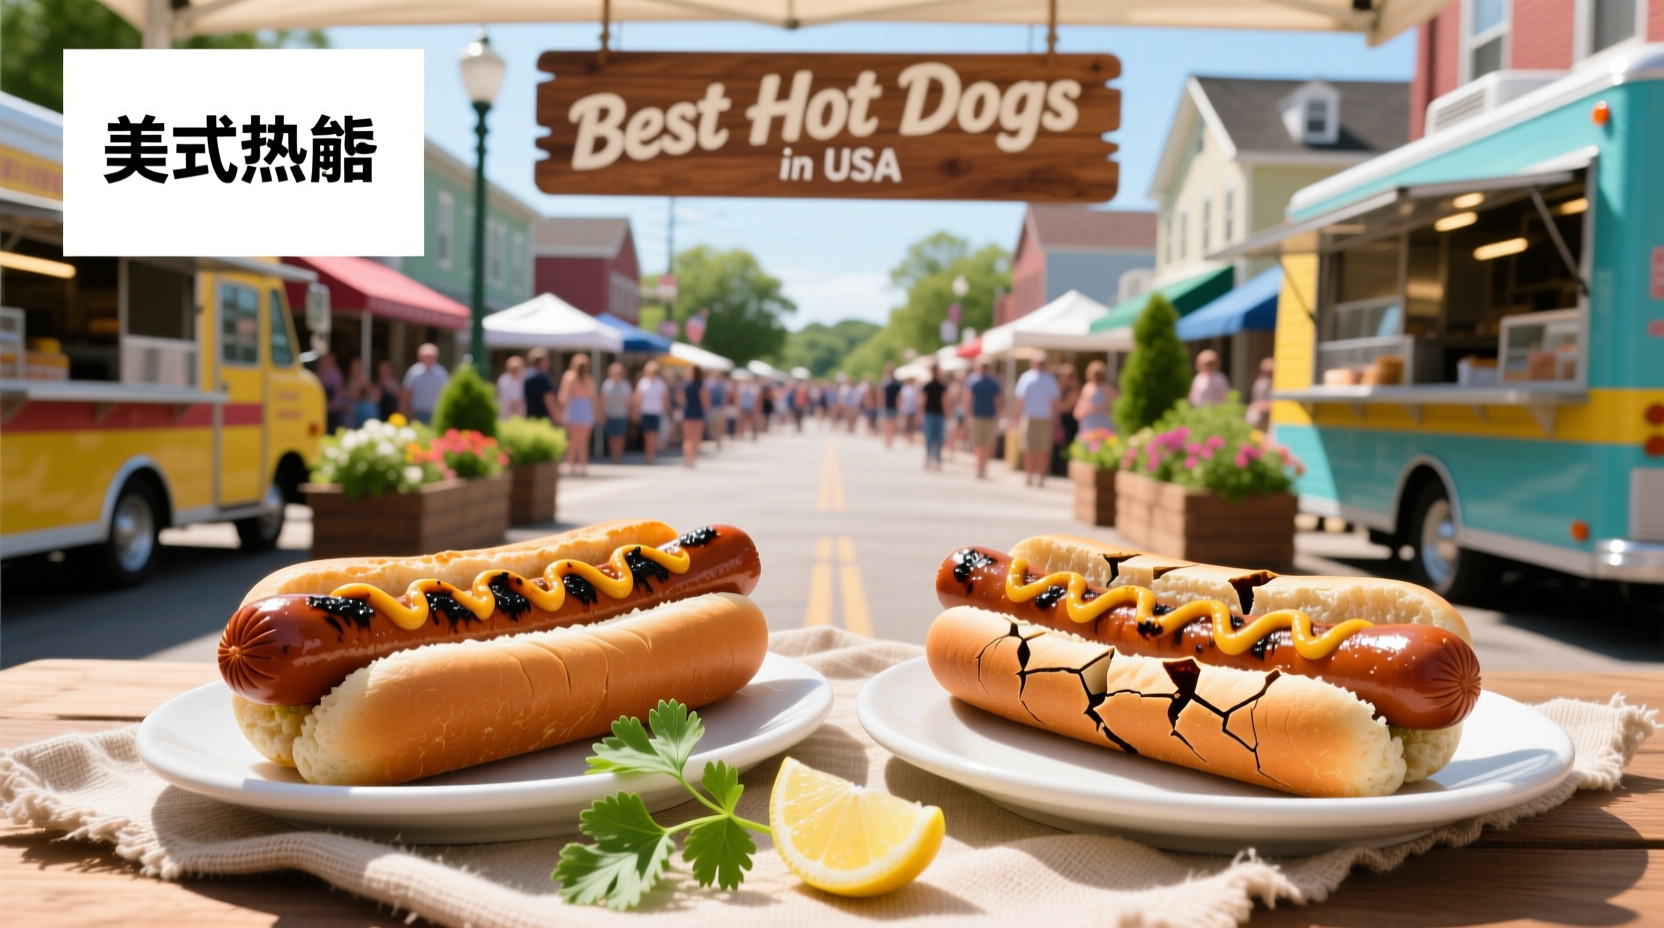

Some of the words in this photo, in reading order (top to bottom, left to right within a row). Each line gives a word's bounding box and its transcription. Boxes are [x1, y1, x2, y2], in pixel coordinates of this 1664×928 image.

[568, 83, 732, 171] Best
[745, 69, 883, 147] Hot
[897, 61, 1082, 154] Dogs
[779, 147, 814, 182] in
[823, 147, 902, 183] USA
